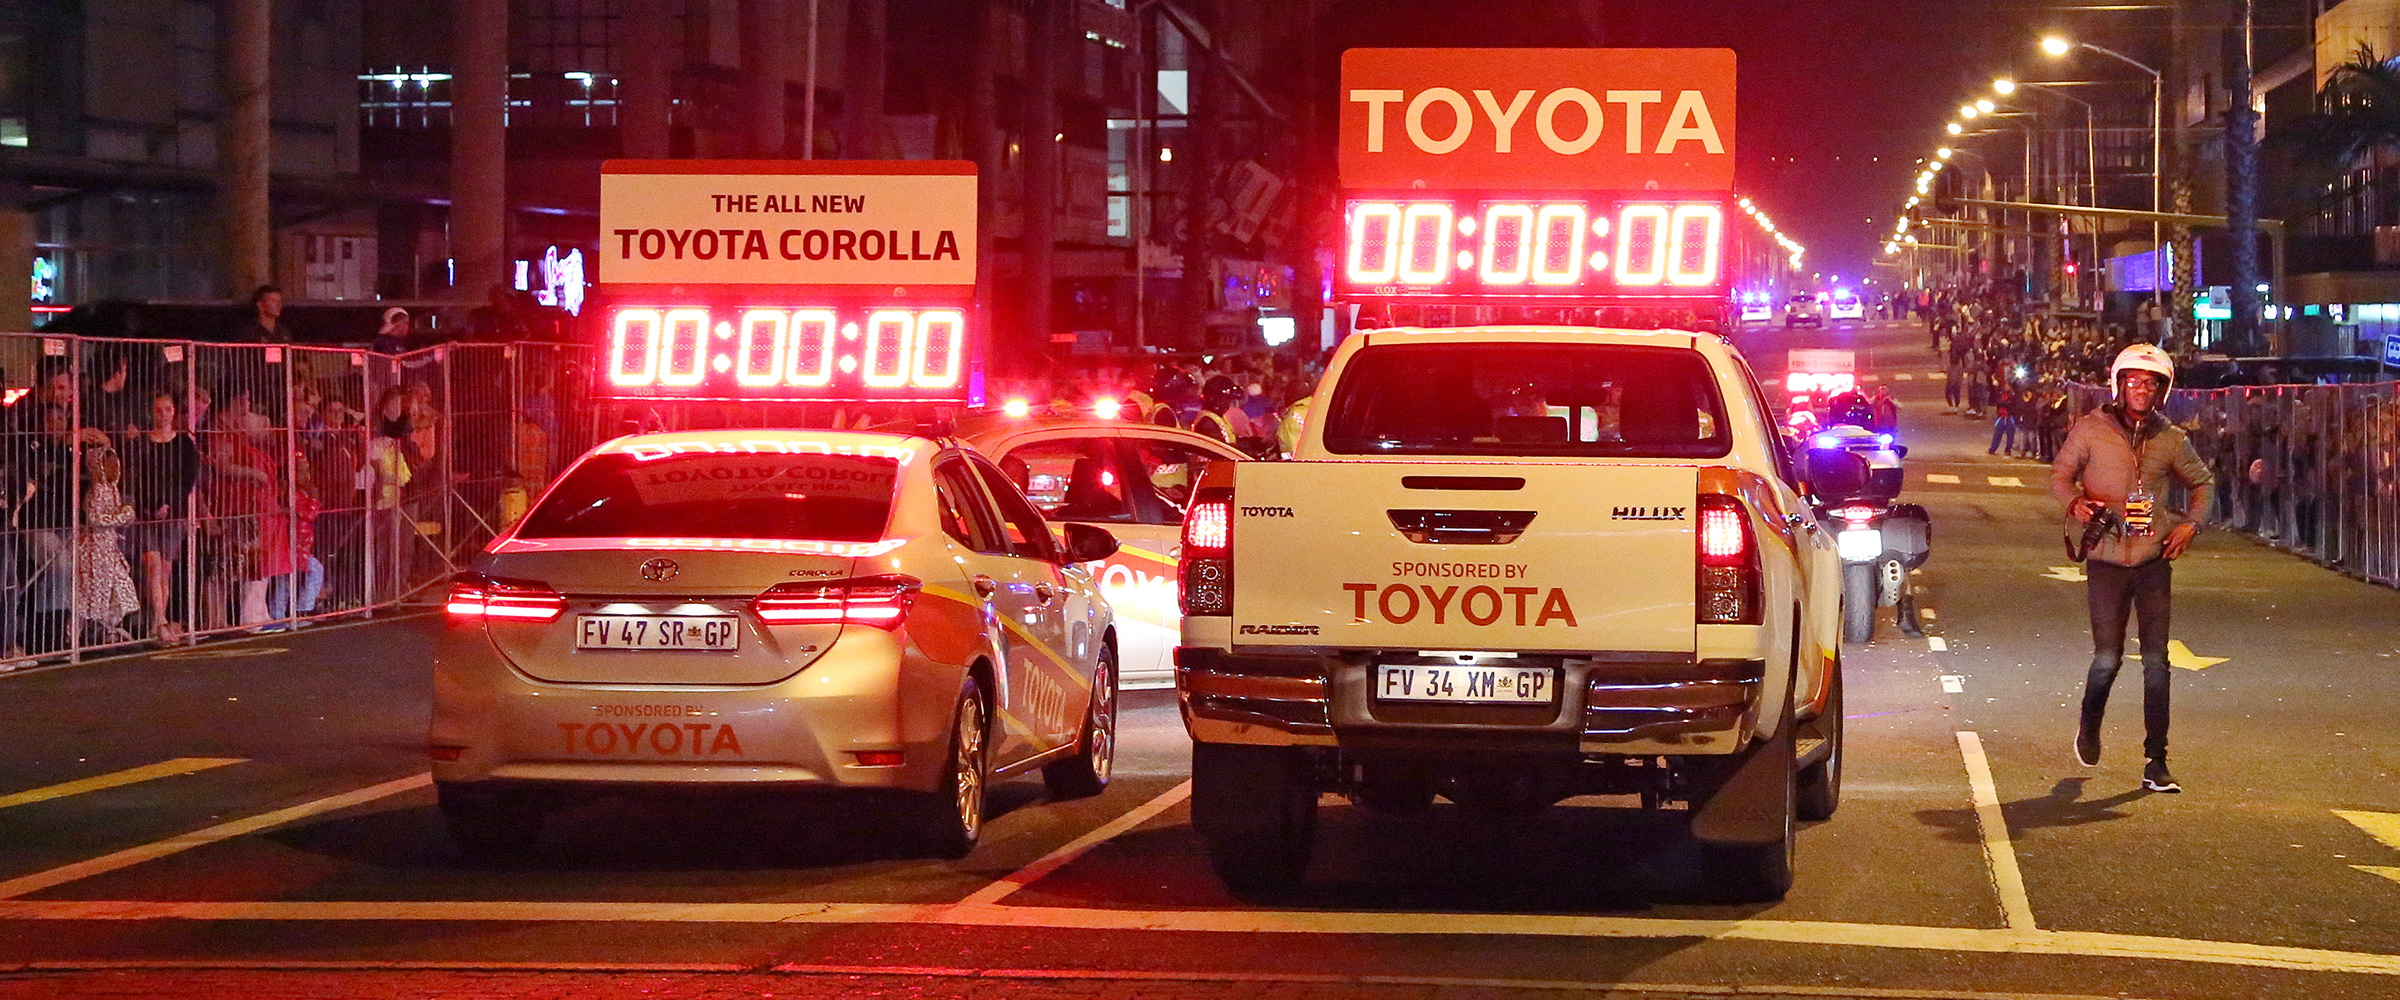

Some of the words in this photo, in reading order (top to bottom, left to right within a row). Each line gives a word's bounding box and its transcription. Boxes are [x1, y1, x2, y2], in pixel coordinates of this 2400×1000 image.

[1350, 87, 1725, 154] TOYOTA
[711, 195, 758, 213] THE
[763, 195, 806, 213] ALL
[811, 195, 865, 213] NEW
[614, 229, 769, 260] TOYOTA
[779, 229, 960, 261] COROLLA
[1347, 203, 1723, 285] 00:00:00
[1374, 286, 1397, 294] CLOX
[610, 309, 964, 388] 00:00:00
[1241, 506, 1294, 518] TOYOTA
[1611, 507, 1686, 520] HILUX
[789, 569, 844, 577] COROLLA
[1392, 562, 1500, 579] SPONSORED
[1505, 564, 1528, 579] BY
[1343, 583, 1578, 627] TOYOTA
[584, 620, 610, 645] FV
[621, 621, 647, 645] 47
[659, 621, 684, 646] SR
[705, 621, 731, 646] GP
[1239, 625, 1320, 635] RAIDER
[1022, 657, 1067, 735] TOYOTA
[1386, 669, 1414, 695] FV
[1426, 670, 1454, 697] 34
[1466, 671, 1495, 697] XM
[1516, 672, 1545, 698] GP
[596, 704, 682, 717] SPONSORED
[685, 705, 704, 717] BY
[557, 722, 743, 756] TOYOTA
